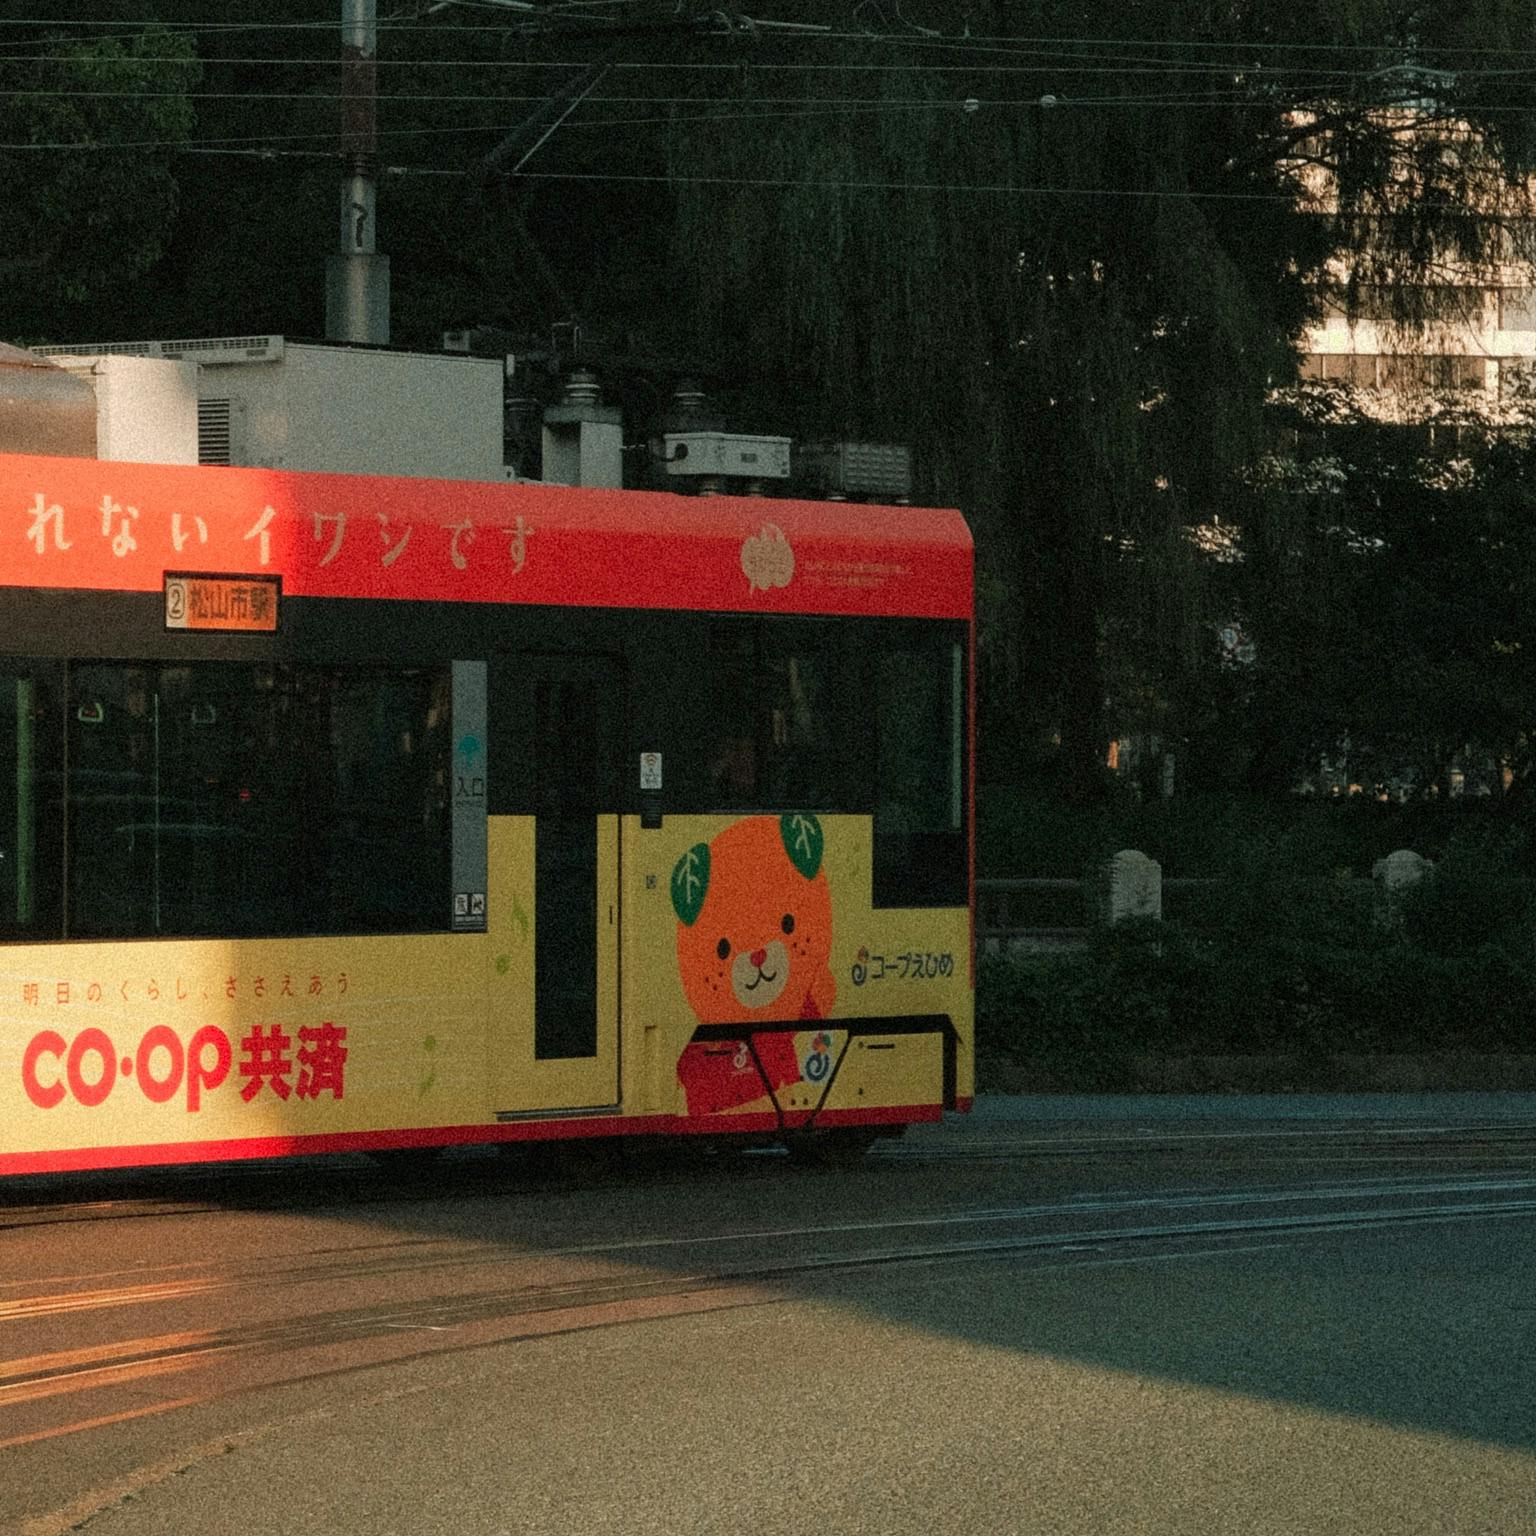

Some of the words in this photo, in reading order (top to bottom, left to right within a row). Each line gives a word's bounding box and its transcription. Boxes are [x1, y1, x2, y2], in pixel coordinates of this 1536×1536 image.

[455, 776, 484, 797] 入口
[872, 952, 954, 980] コープえひめ
